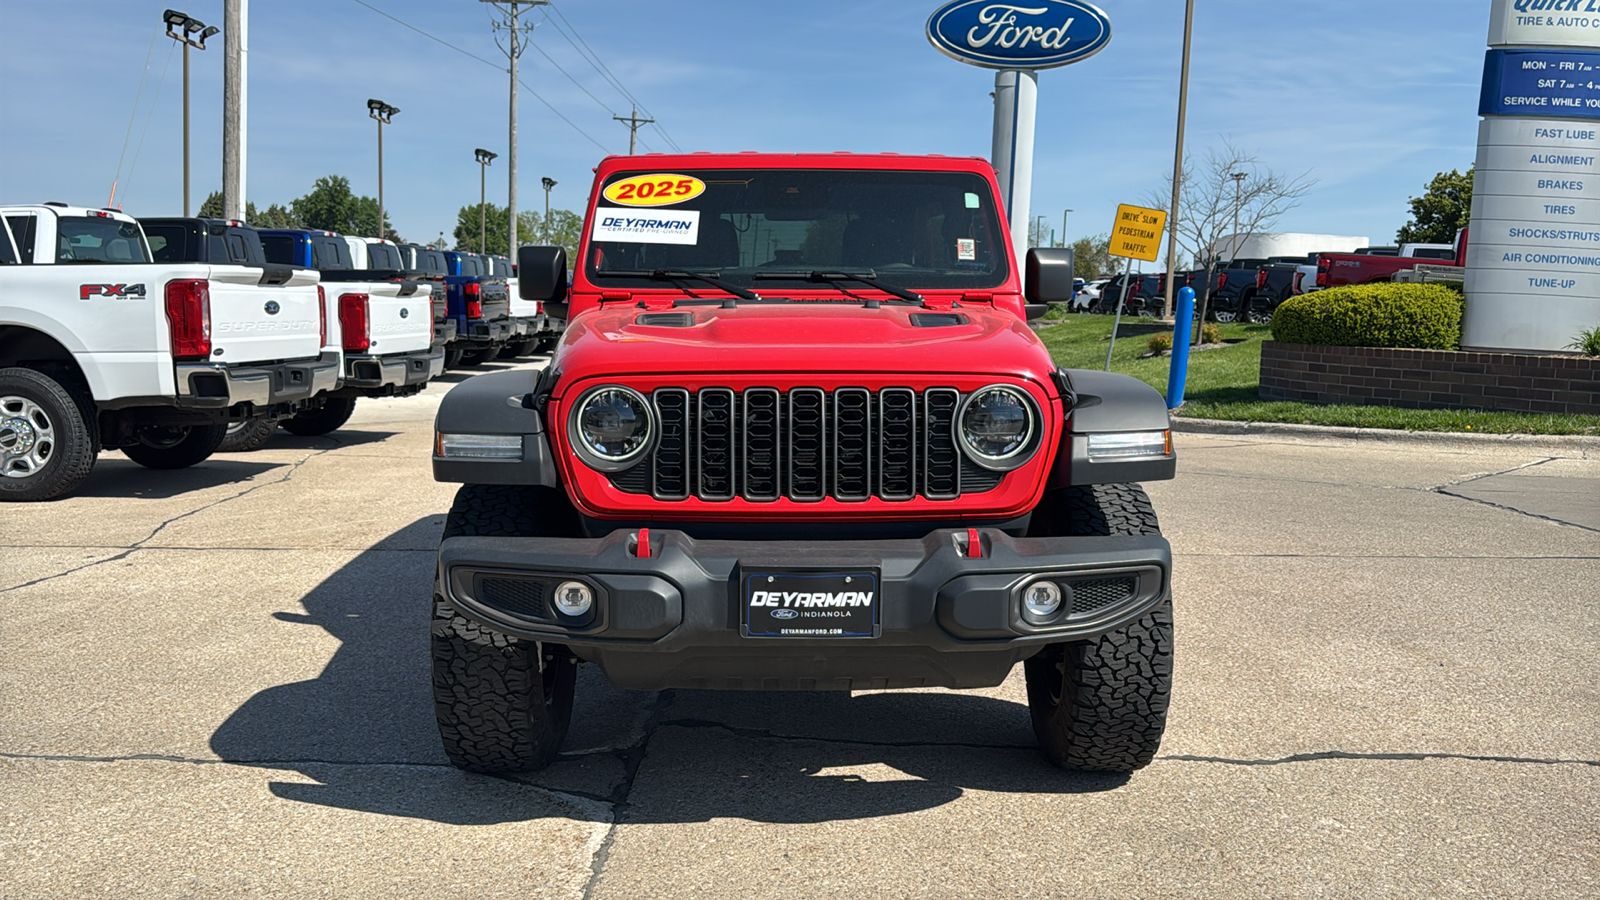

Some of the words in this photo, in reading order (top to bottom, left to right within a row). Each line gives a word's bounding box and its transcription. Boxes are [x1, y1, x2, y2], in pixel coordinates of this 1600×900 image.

[1584, 0, 1600, 13] L
[967, 4, 1074, 50] Ford
[1516, 16, 1543, 26] TIRE
[1546, 16, 1553, 26] &
[1556, 17, 1589, 27] AUTO
[1522, 61, 1547, 70] MON
[1559, 61, 1575, 70] FRI
[1537, 79, 1557, 88] SAT
[1504, 96, 1548, 106] SERVICE
[1552, 98, 1581, 107] WHILE
[1535, 128, 1564, 138] FAST
[1566, 129, 1596, 140] LUBE
[1530, 154, 1595, 166] ALIGNMENT
[616, 179, 693, 200] 2025
[1537, 179, 1583, 191] BRAKES
[1544, 204, 1576, 215] TIRES
[602, 217, 693, 231] DEYARMAN
[1122, 212, 1140, 223] DRIVE
[1143, 214, 1158, 225] SLOW
[1119, 226, 1155, 239] PEDESTRIAN
[1509, 227, 1600, 242] SHOCKS/STRUTS
[1122, 242, 1147, 253] TRAFFIC
[1502, 253, 1522, 263] AIR
[1525, 253, 1600, 266] CONDITIONING
[1528, 277, 1576, 289] TUNE-UP
[80, 283, 147, 300] FX4
[219, 321, 278, 332] SUPER
[280, 320, 316, 330] DUTY
[750, 591, 873, 607] DEYARMAN
[800, 610, 852, 618] INDIANOLA
